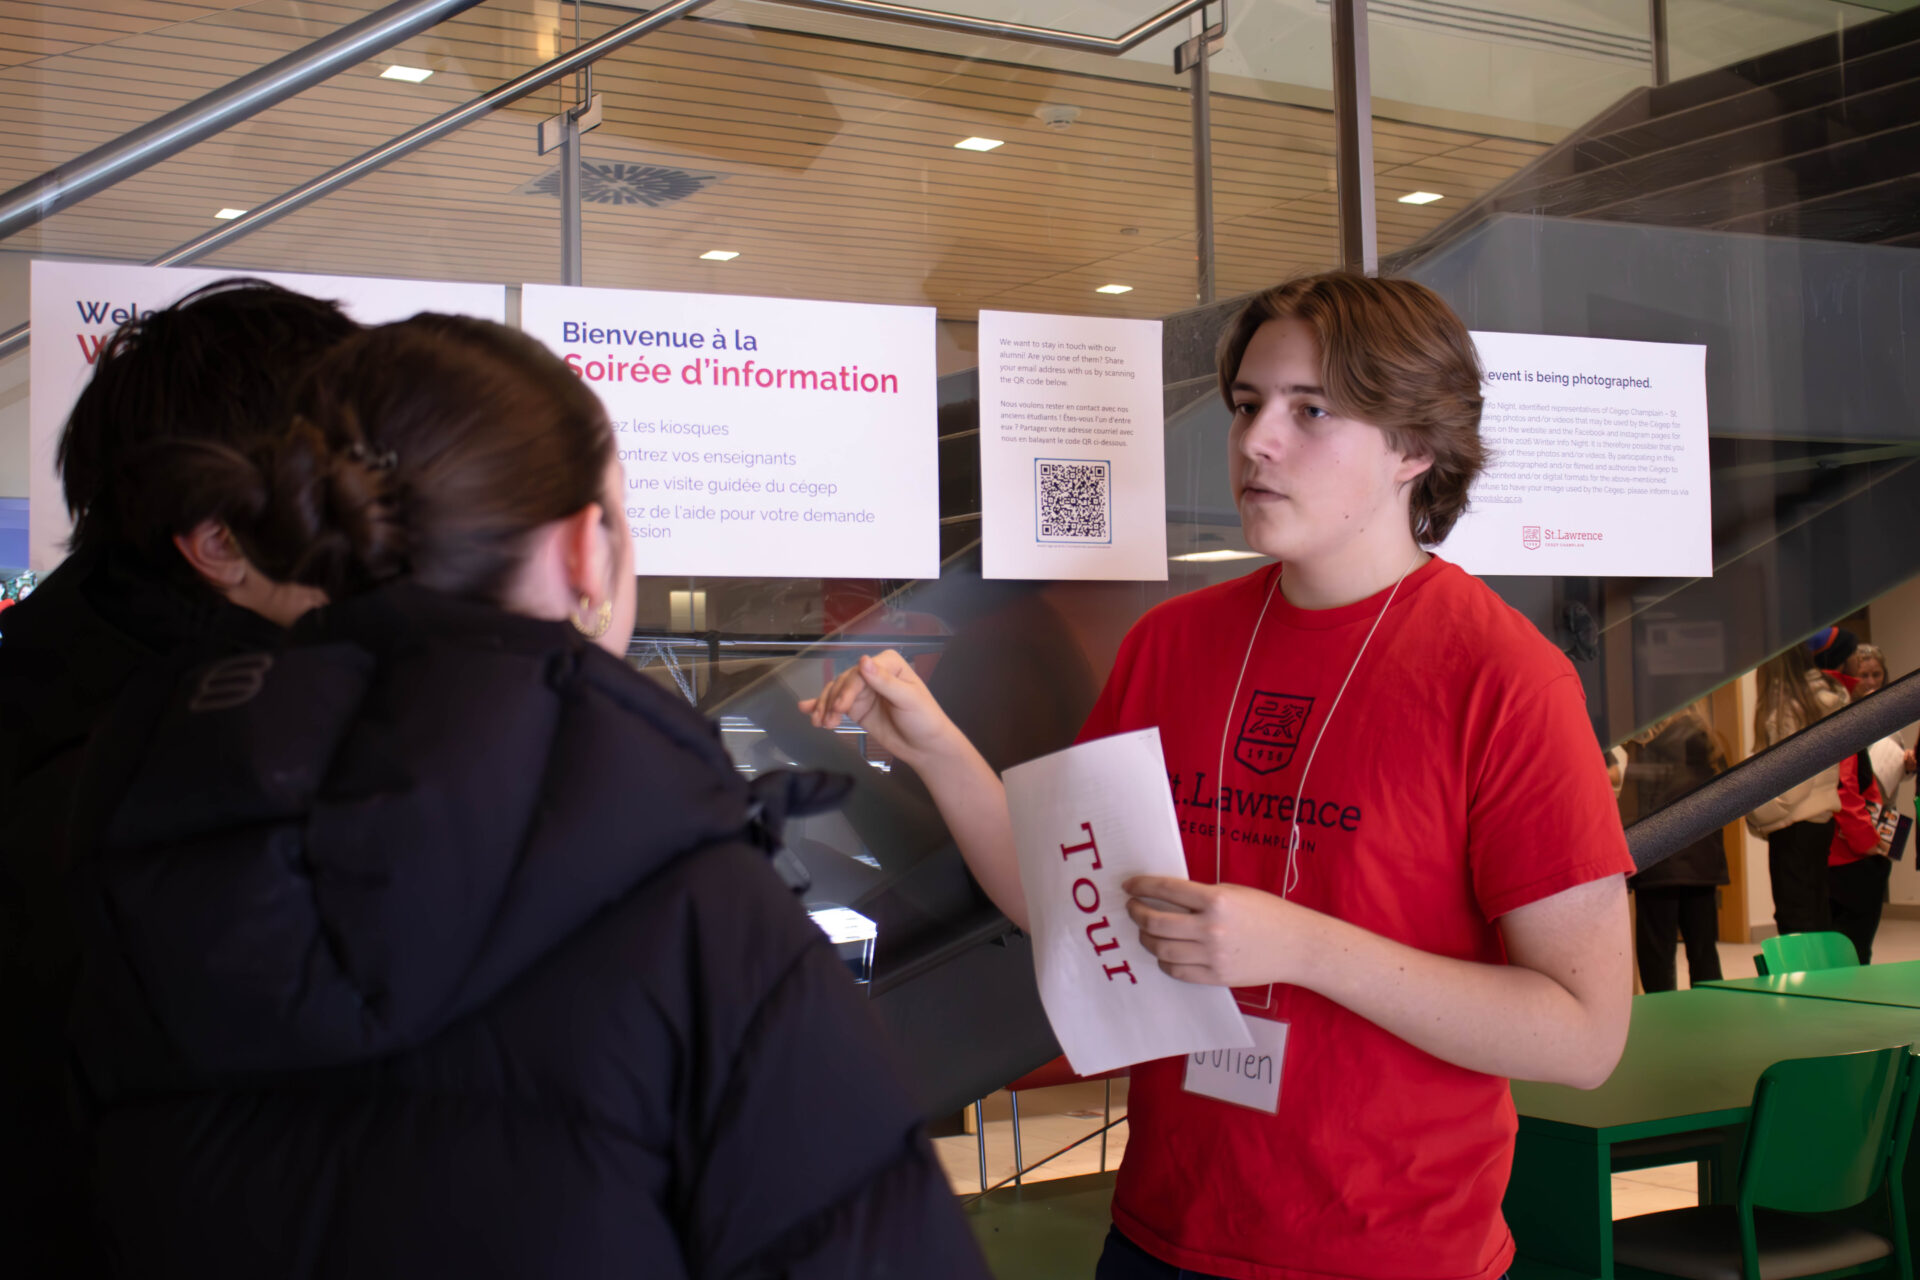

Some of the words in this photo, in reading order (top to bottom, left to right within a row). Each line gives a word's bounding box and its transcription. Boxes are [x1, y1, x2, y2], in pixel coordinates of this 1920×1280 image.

[563, 322, 705, 349] Bienvenue
[712, 328, 727, 349] à
[735, 329, 757, 351] la
[1013, 339, 1030, 347] want
[1042, 341, 1056, 350] stay
[1066, 342, 1086, 350] touch
[1081, 355, 1102, 363] them?
[1104, 356, 1124, 364] Share
[564, 353, 672, 384] Soirée
[682, 359, 898, 395] d'information
[1000, 365, 1016, 373] your
[1017, 365, 1037, 373] email
[1038, 366, 1066, 374] address
[1068, 367, 1083, 375] with
[1094, 368, 1103, 377] by
[1104, 369, 1135, 379] scanning
[1488, 370, 1521, 381] event
[1525, 371, 1534, 382] is
[1537, 372, 1570, 386] being
[1573, 374, 1652, 389] photographed.
[1026, 377, 1044, 385] code
[1000, 400, 1018, 408] Nous
[1019, 401, 1044, 409] voulons
[1045, 402, 1064, 410] rester
[1027, 413, 1058, 421] étudiants
[633, 420, 655, 433] les
[661, 420, 729, 438] kiosques
[1020, 425, 1047, 434] Partagez
[1067, 426, 1092, 434] adresse
[1093, 427, 1118, 435] courriel
[1029, 436, 1056, 445] balayant
[1065, 437, 1081, 445] code
[616, 448, 667, 462] ontrez
[672, 452, 699, 463] vos
[704, 450, 797, 468] enseignants
[629, 479, 659, 490] une
[664, 477, 704, 491] visite
[708, 478, 761, 495] guidée
[765, 480, 785, 492] du
[789, 480, 837, 497] cégep
[650, 506, 671, 519] de
[674, 506, 715, 519] l'aide
[720, 509, 754, 523] pour
[760, 508, 798, 521] votre
[803, 508, 875, 522] demande
[1168, 772, 1361, 831] t.Lawrence
[1060, 822, 1138, 984] Tour
